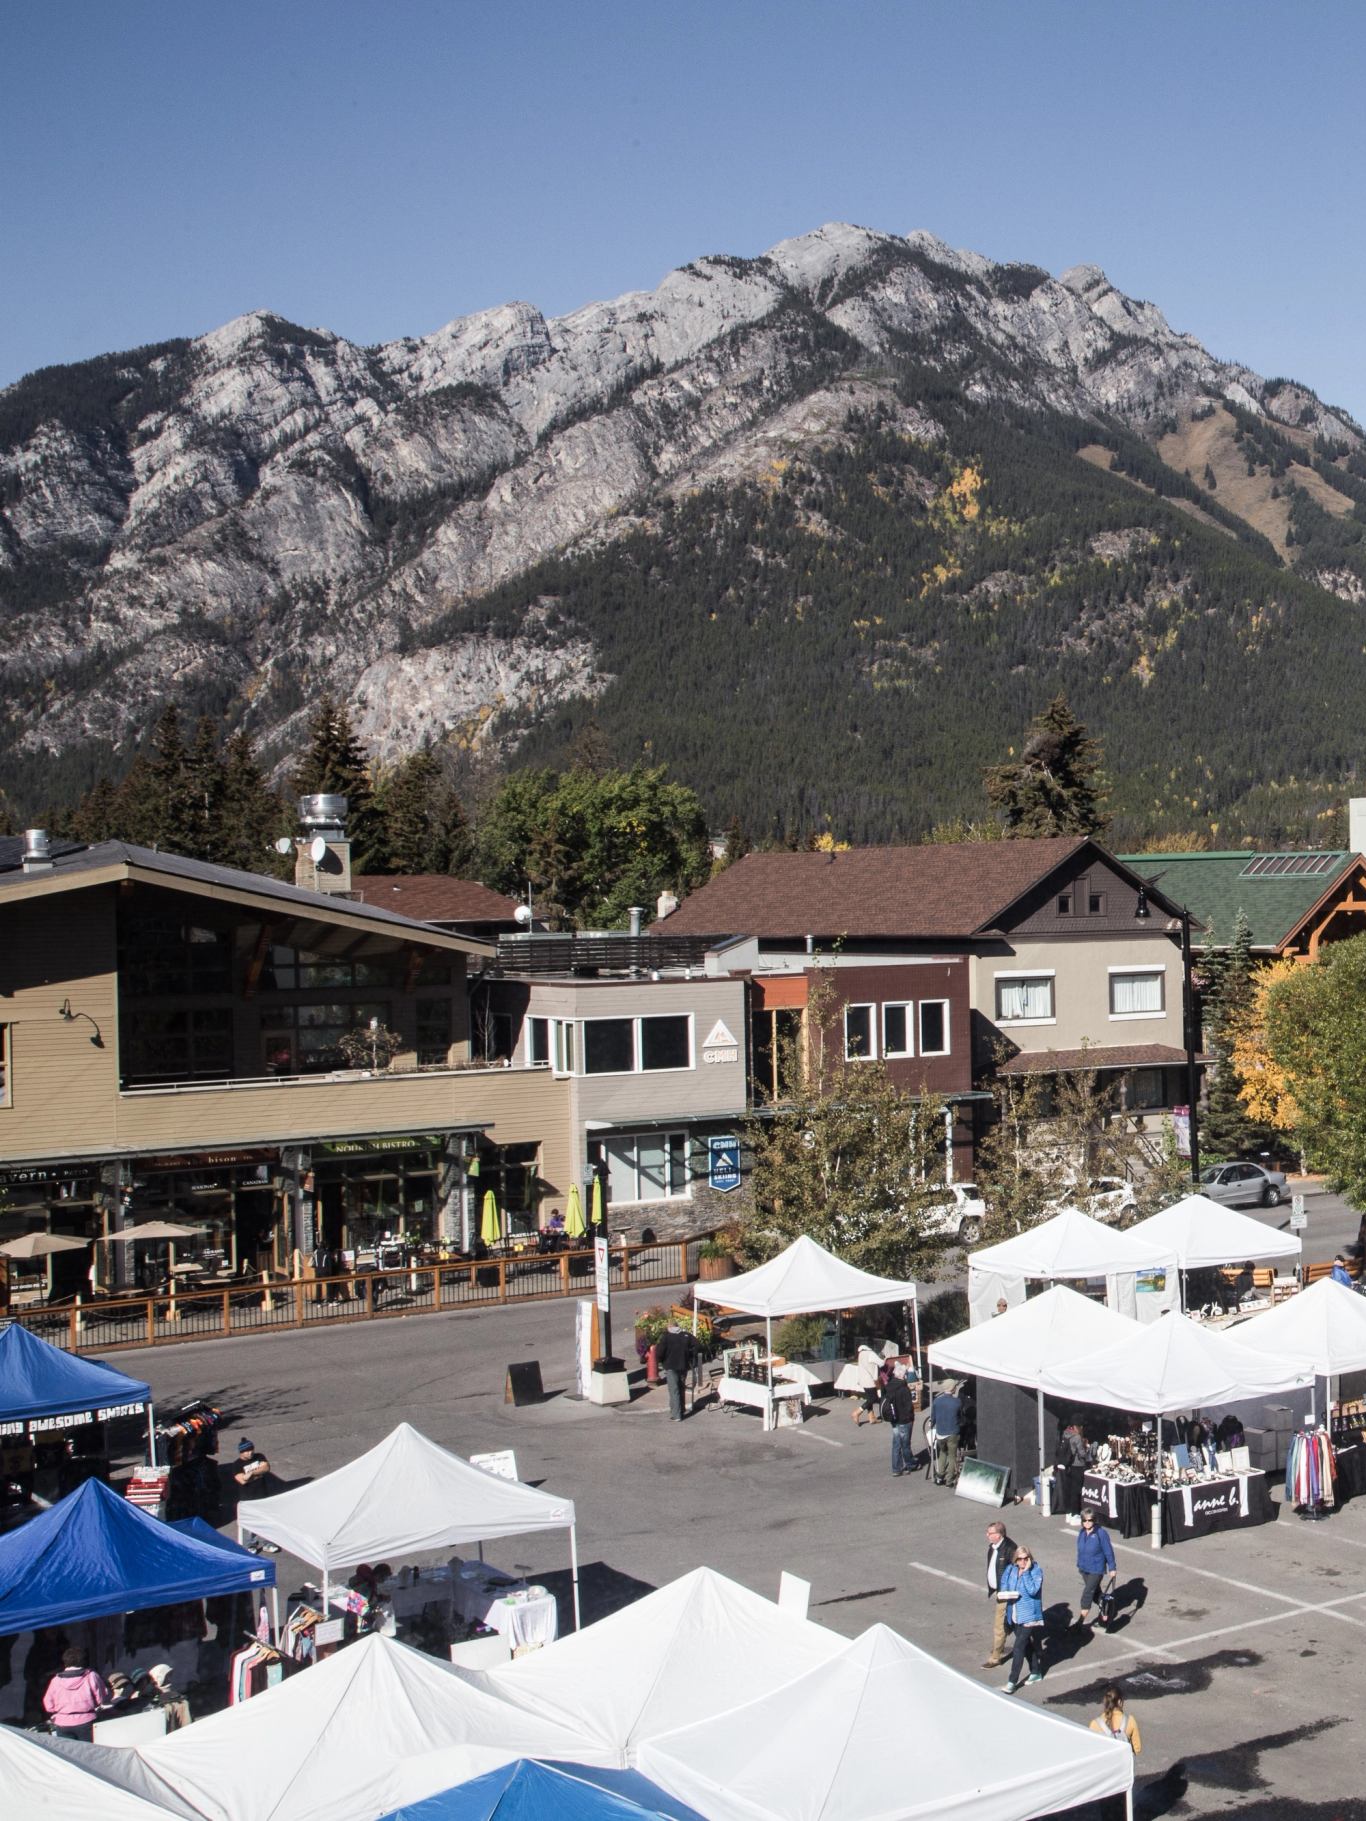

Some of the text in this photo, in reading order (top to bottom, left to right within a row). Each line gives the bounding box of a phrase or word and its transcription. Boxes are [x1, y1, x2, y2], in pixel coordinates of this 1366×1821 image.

[704, 1049, 738, 1063] CMH
[382, 1140, 415, 1149] BISTRO
[208, 1156, 237, 1164] bison
[1194, 1486, 1240, 1512] anne b.
